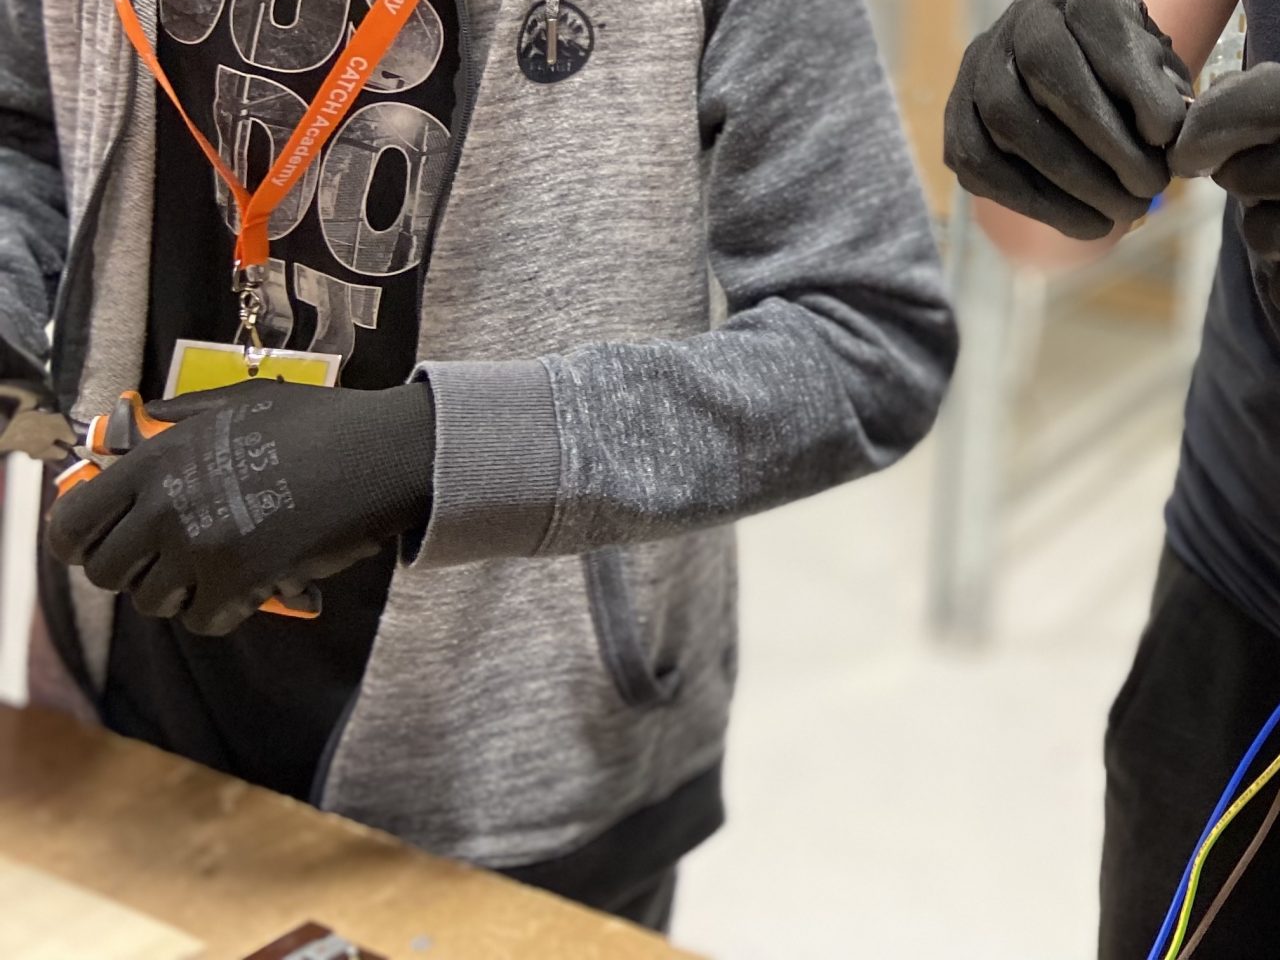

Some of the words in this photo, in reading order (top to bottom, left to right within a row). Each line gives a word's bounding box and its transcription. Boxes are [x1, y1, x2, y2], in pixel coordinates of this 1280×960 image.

[320, 56, 369, 115] CATCH
[211, 64, 455, 277] DO
[271, 115, 331, 187] Academy
